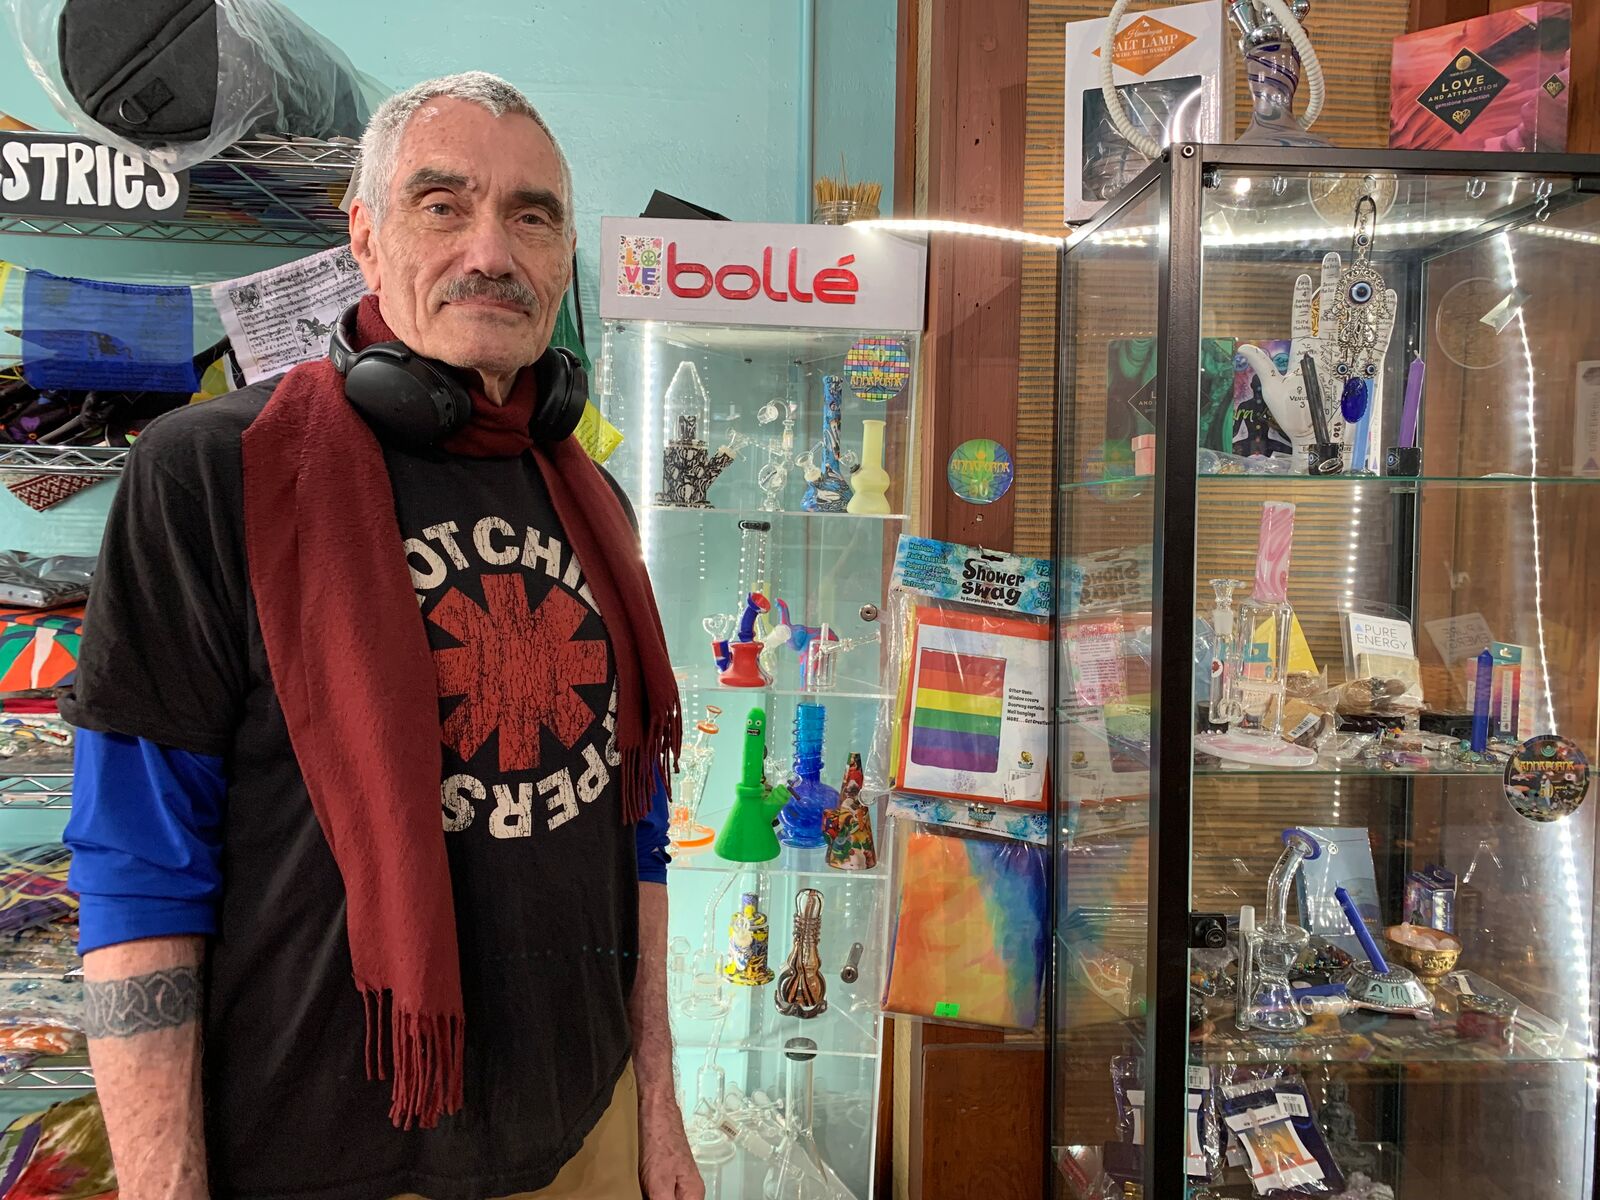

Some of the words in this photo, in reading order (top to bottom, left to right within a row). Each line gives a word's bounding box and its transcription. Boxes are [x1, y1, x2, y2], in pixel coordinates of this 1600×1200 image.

[1142, 34, 1178, 48] LAMP
[1441, 74, 1485, 92] LOVE
[1428, 94, 1444, 102] AND
[1447, 83, 1498, 98] ATTRACTION
[1463, 93, 1490, 104] collection
[667, 241, 859, 305] bollé
[962, 558, 1026, 587] Shower
[962, 581, 1022, 606] swag
[1365, 624, 1398, 637] PURE
[1356, 634, 1408, 650] ENERGY
